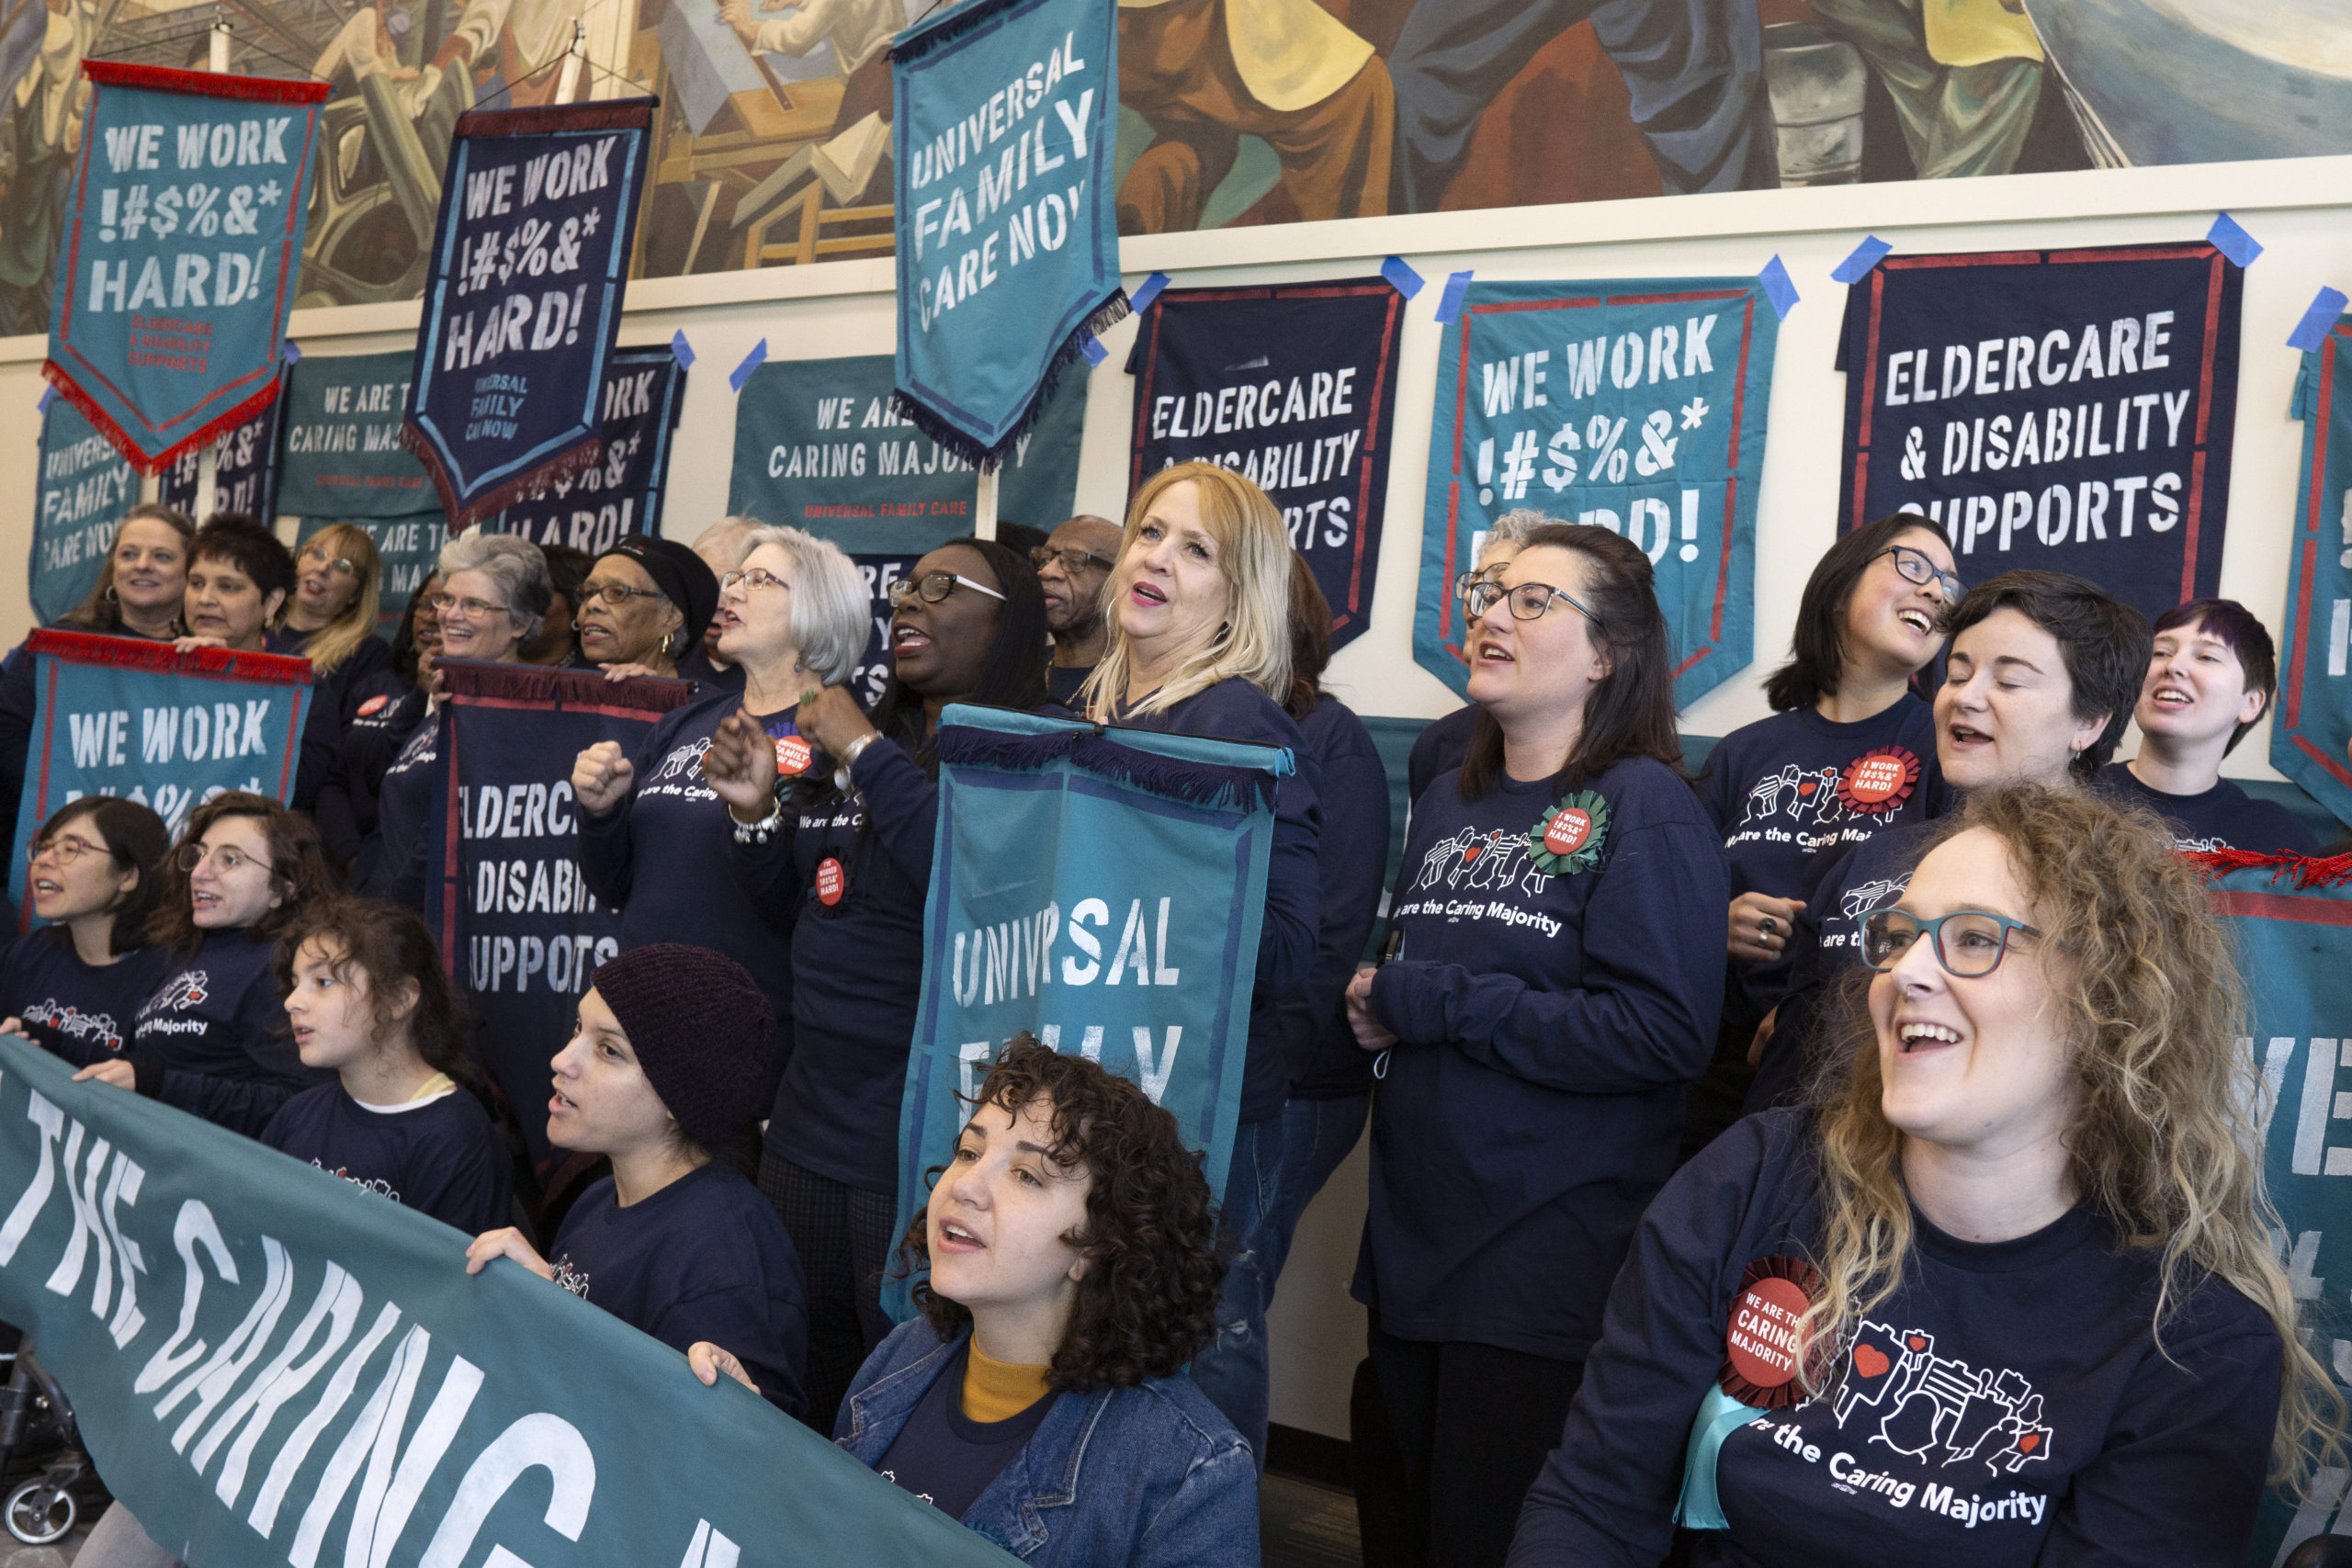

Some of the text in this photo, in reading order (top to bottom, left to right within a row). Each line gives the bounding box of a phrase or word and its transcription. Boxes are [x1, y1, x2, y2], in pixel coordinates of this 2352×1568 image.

[911, 30, 1085, 189] UNIVERSAL
[105, 117, 291, 173] WE WORK
[466, 135, 617, 220] WE WORK
[915, 88, 1094, 264] FAMILY
[88, 246, 266, 312] HARD!
[921, 231, 999, 333] CARE
[132, 314, 213, 337] ELDERCARE
[444, 283, 587, 371] HARD!
[128, 351, 209, 374] SUPPORTS
[1483, 314, 1719, 418] WE WORK
[1885, 310, 2175, 406] ELDERCARE
[324, 387, 352, 413] WE
[356, 383, 394, 413] ARE
[818, 396, 916, 430] WE AR
[1153, 367, 1356, 440] ELDERCARE
[289, 424, 357, 453] CARING
[1900, 389, 2191, 481] & DISABILITY
[767, 443, 866, 479] CARING
[43, 460, 130, 529] FAMILY
[804, 501, 967, 519] UNIVERSAL FAMILY CARE
[1896, 472, 2182, 555] UPPORTS
[380, 523, 420, 552] ARE
[69, 700, 271, 769] WE WORK
[778, 739, 809, 754] UNIVERSA
[1855, 779, 1893, 792] HARD!
[1863, 761, 1900, 772] I WORK
[662, 784, 682, 795] the
[684, 785, 718, 800] Caring
[799, 816, 812, 829] We
[831, 814, 849, 827] the
[1548, 829, 1577, 845] HARD!
[1564, 813, 1588, 827] WORK
[1737, 830, 1761, 841] are
[1765, 827, 1792, 842] the
[1796, 831, 1838, 848] Caring
[820, 883, 839, 896] HARD!
[1401, 903, 1419, 916] are
[1422, 898, 1443, 915] the
[1445, 899, 1486, 920] Caring
[1486, 901, 1562, 939] Majority
[1823, 933, 1846, 948] are
[153, 1017, 209, 1036] Majority
[0, 1088, 596, 1568] THE CARING
[1746, 1292, 1803, 1330] WE ARE TH
[1730, 1329, 1792, 1371] MAJORITY
[1737, 1309, 1798, 1354] CARING
[1773, 1424, 1822, 1463] the
[1828, 1451, 1917, 1508] Caring
[1919, 1482, 2048, 1529] Majority
